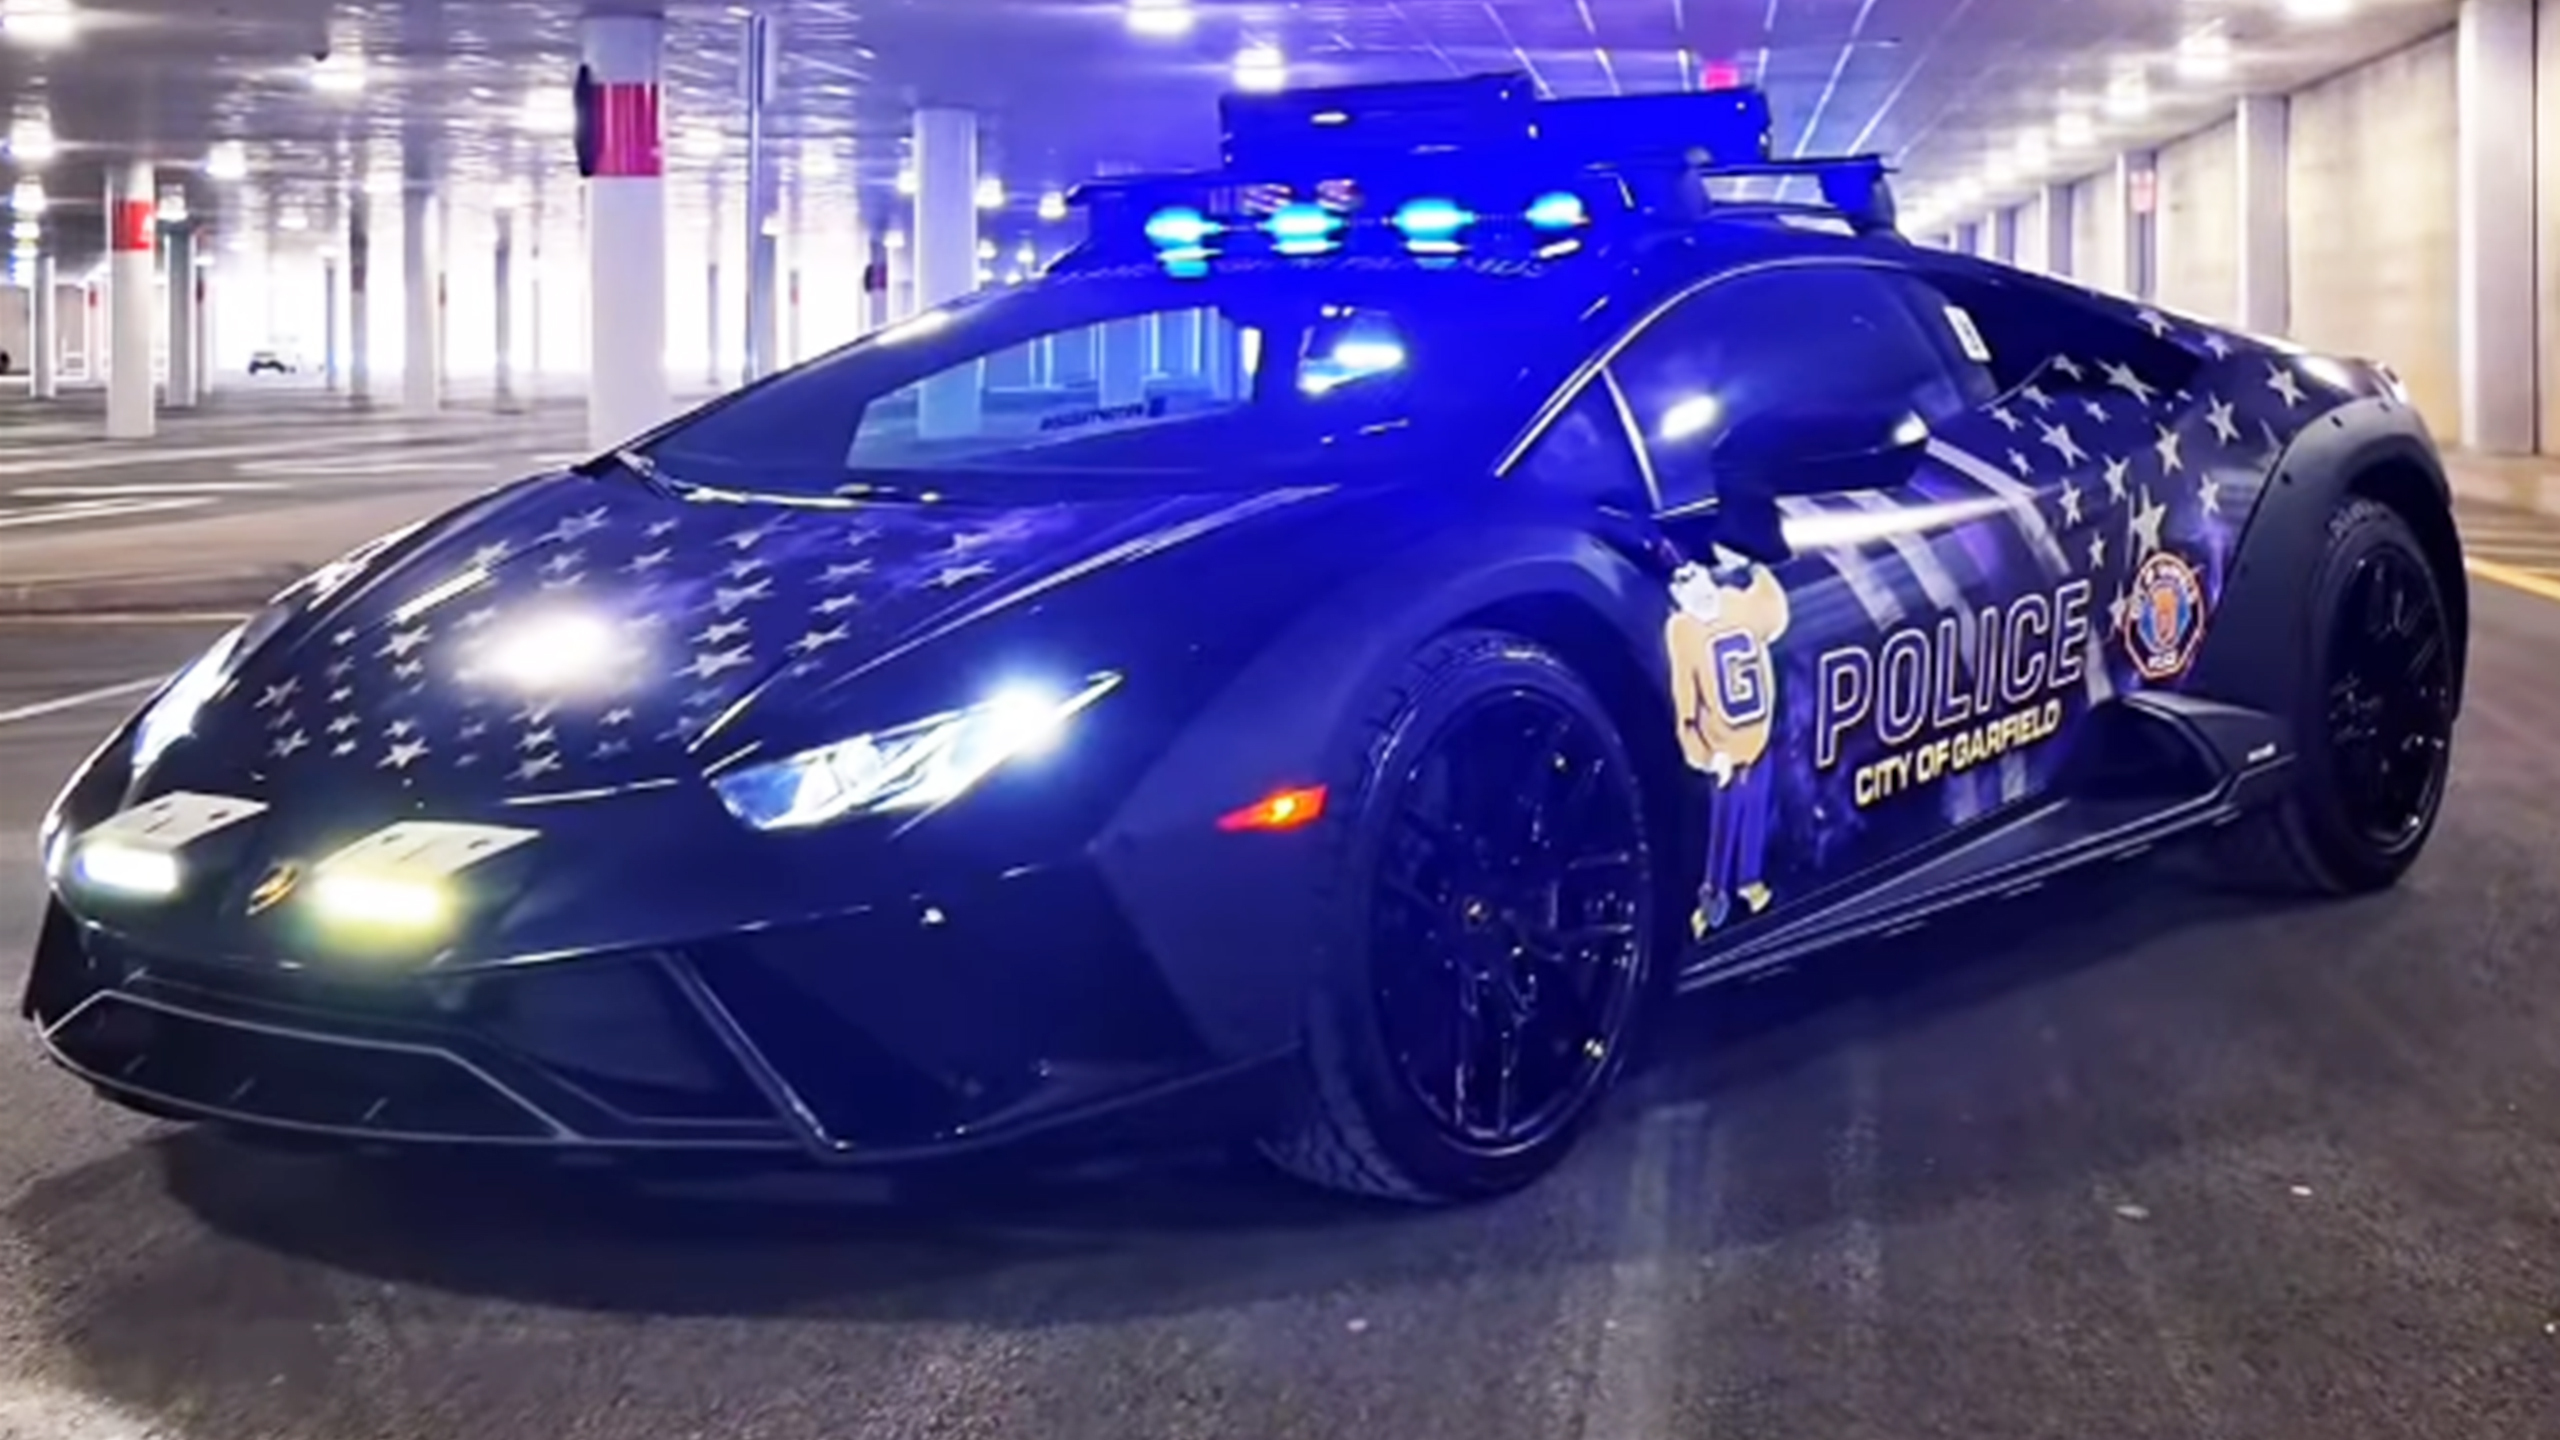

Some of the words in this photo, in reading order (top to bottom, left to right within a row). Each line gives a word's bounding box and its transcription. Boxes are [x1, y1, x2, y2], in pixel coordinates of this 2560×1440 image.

[1706, 627, 1767, 725] G
[1815, 578, 2092, 769] POLICE
[1854, 752, 1913, 807] CITY
[1916, 739, 1950, 783] OF
[1951, 698, 2061, 770] GARFIELD
